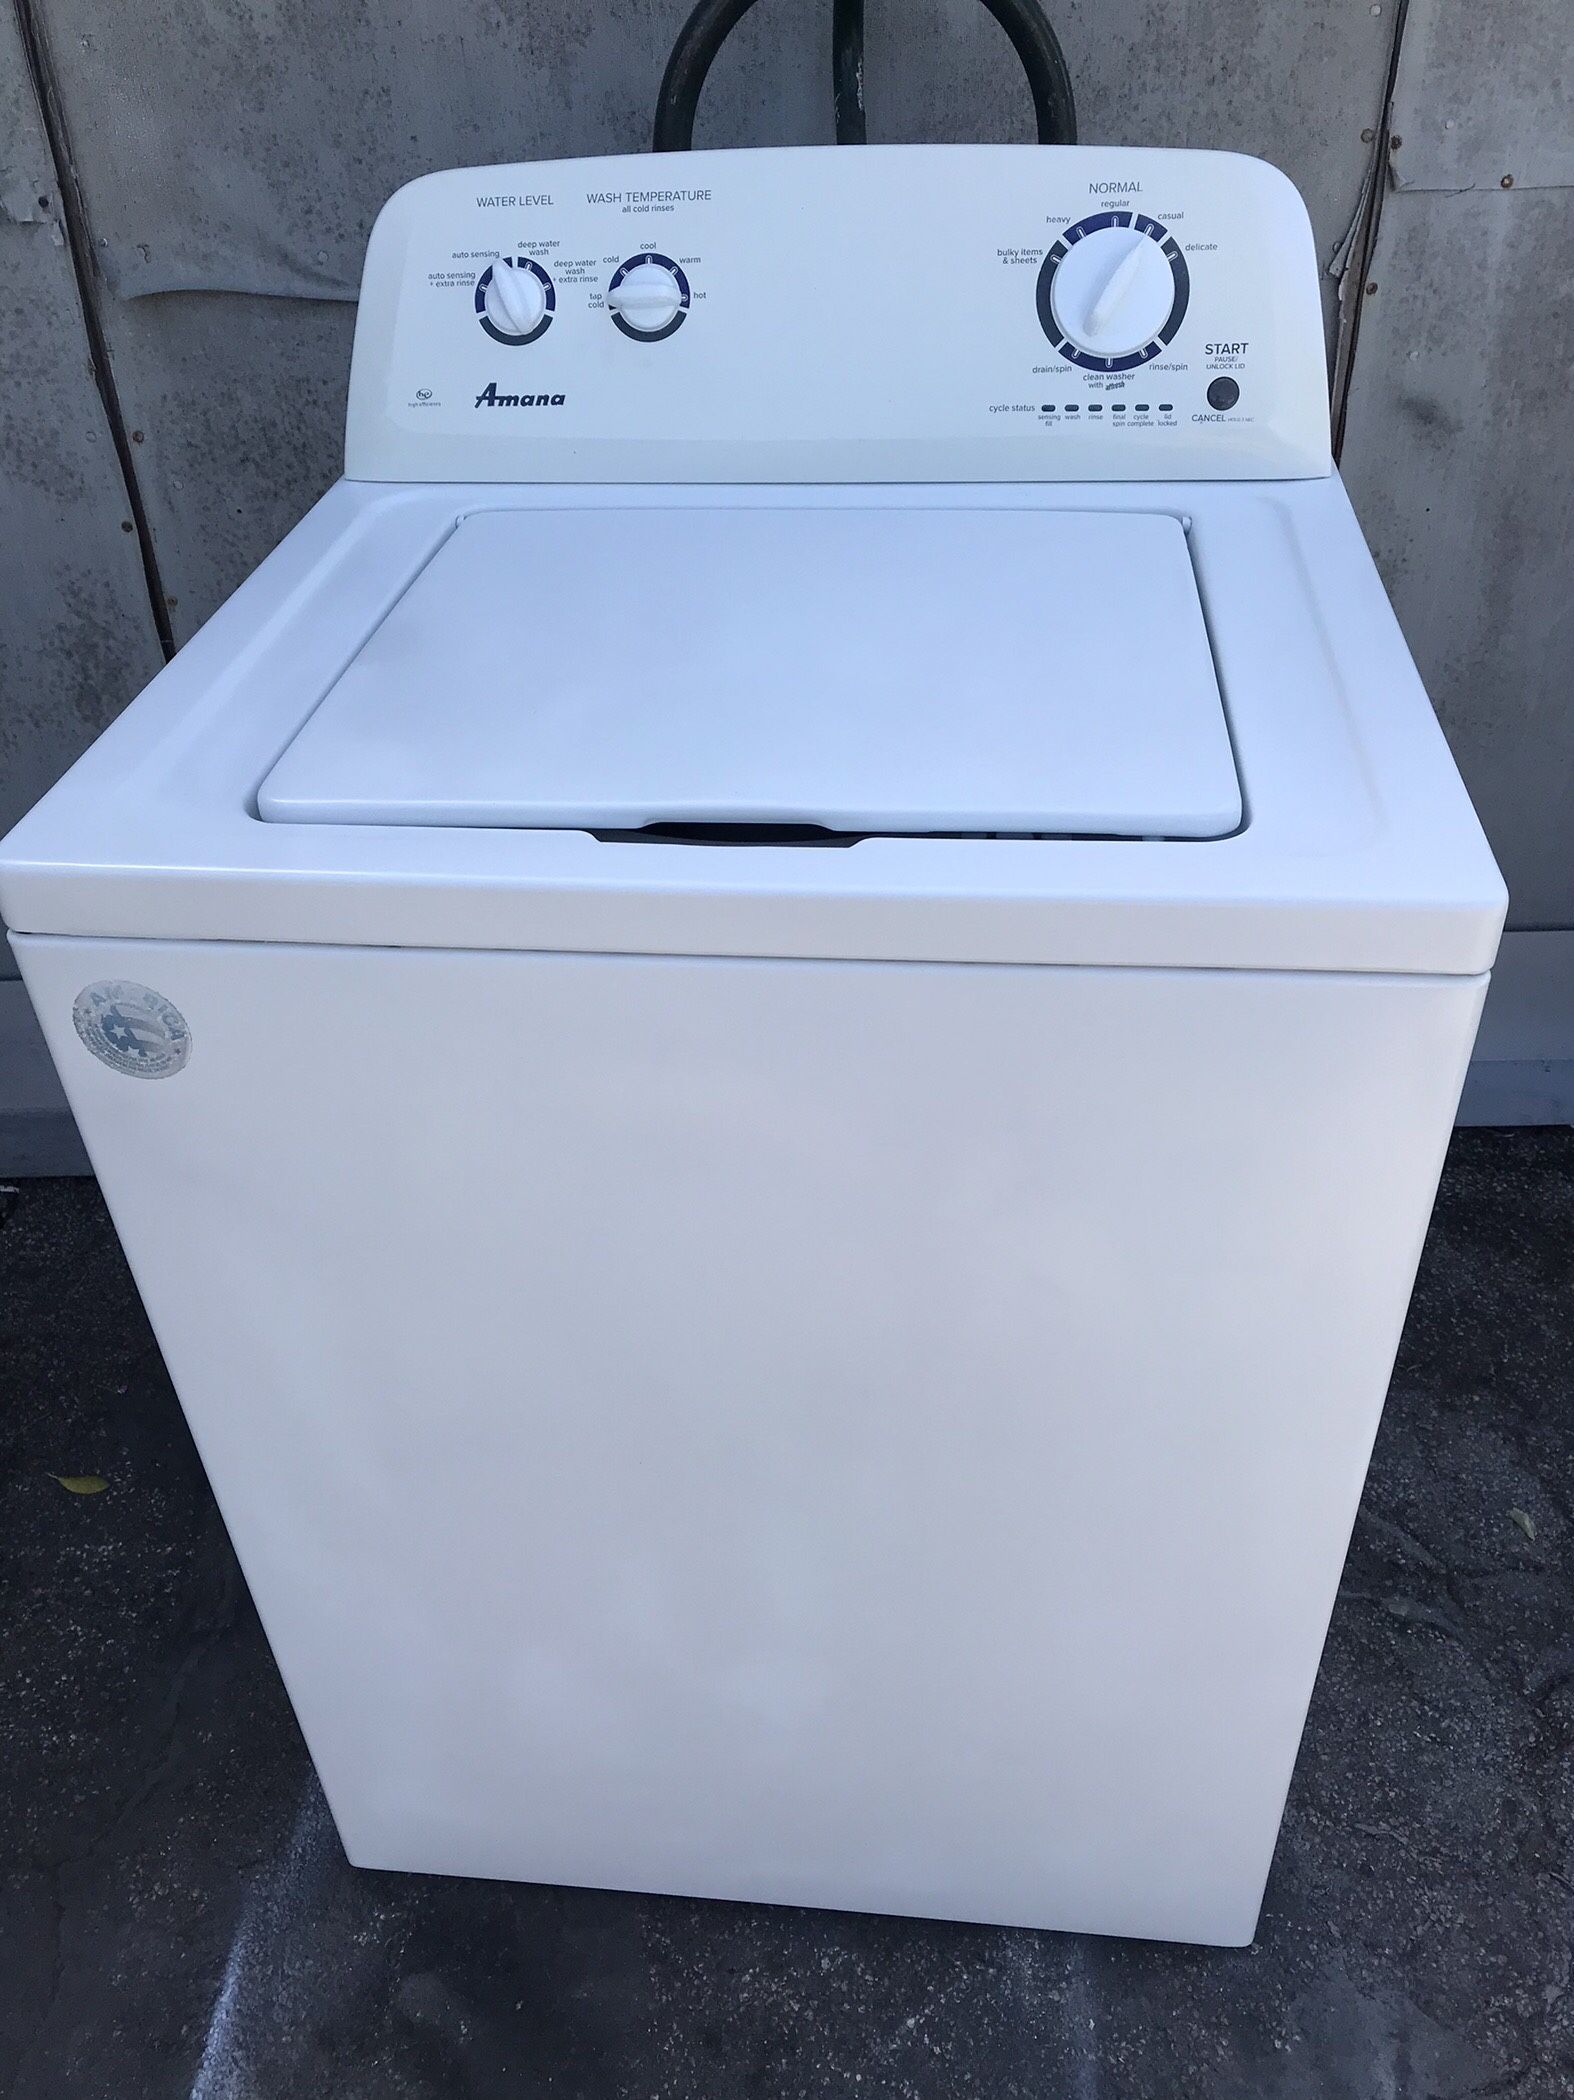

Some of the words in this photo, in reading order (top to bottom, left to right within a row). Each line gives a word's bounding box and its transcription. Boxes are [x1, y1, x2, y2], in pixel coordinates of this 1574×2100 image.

[1089, 182, 1143, 194] NORMAL
[477, 196, 516, 207] WATER
[519, 195, 554, 206] LEVEL
[587, 192, 622, 204] WASH
[626, 190, 712, 202] TEMPERATURE
[622, 205, 632, 213] all
[651, 204, 674, 212] rinses
[1100, 200, 1130, 208] regular
[1046, 215, 1071, 224] heavy
[1158, 212, 1184, 220] casual
[518, 240, 537, 249] deep
[538, 240, 560, 248] water
[640, 242, 657, 250] cool
[1185, 243, 1218, 251] delicate
[452, 251, 469, 259] auto
[470, 250, 500, 259] sensing
[529, 248, 549, 256] wash
[997, 248, 1018, 258] bulky
[1020, 248, 1043, 256] items
[554, 259, 572, 268] deep
[574, 259, 596, 267] water
[679, 256, 701, 264] warm
[1002, 256, 1008, 264] &
[1010, 256, 1038, 264] sheets
[428, 272, 444, 280] auto
[445, 272, 476, 281] sensing
[558, 275, 578, 284] extra
[580, 275, 599, 283] rinse
[589, 293, 602, 301] tap
[588, 301, 604, 309] cold
[1205, 343, 1248, 355] START
[1032, 365, 1072, 374] drain/spin
[1149, 363, 1188, 372] rinse/spin
[1083, 373, 1104, 381] clean
[474, 382, 565, 408] Amana
[989, 404, 1009, 413] cycle
[1012, 404, 1036, 412] status
[1192, 414, 1226, 422] CANCEL
[90, 985, 186, 1041] AMRICA
